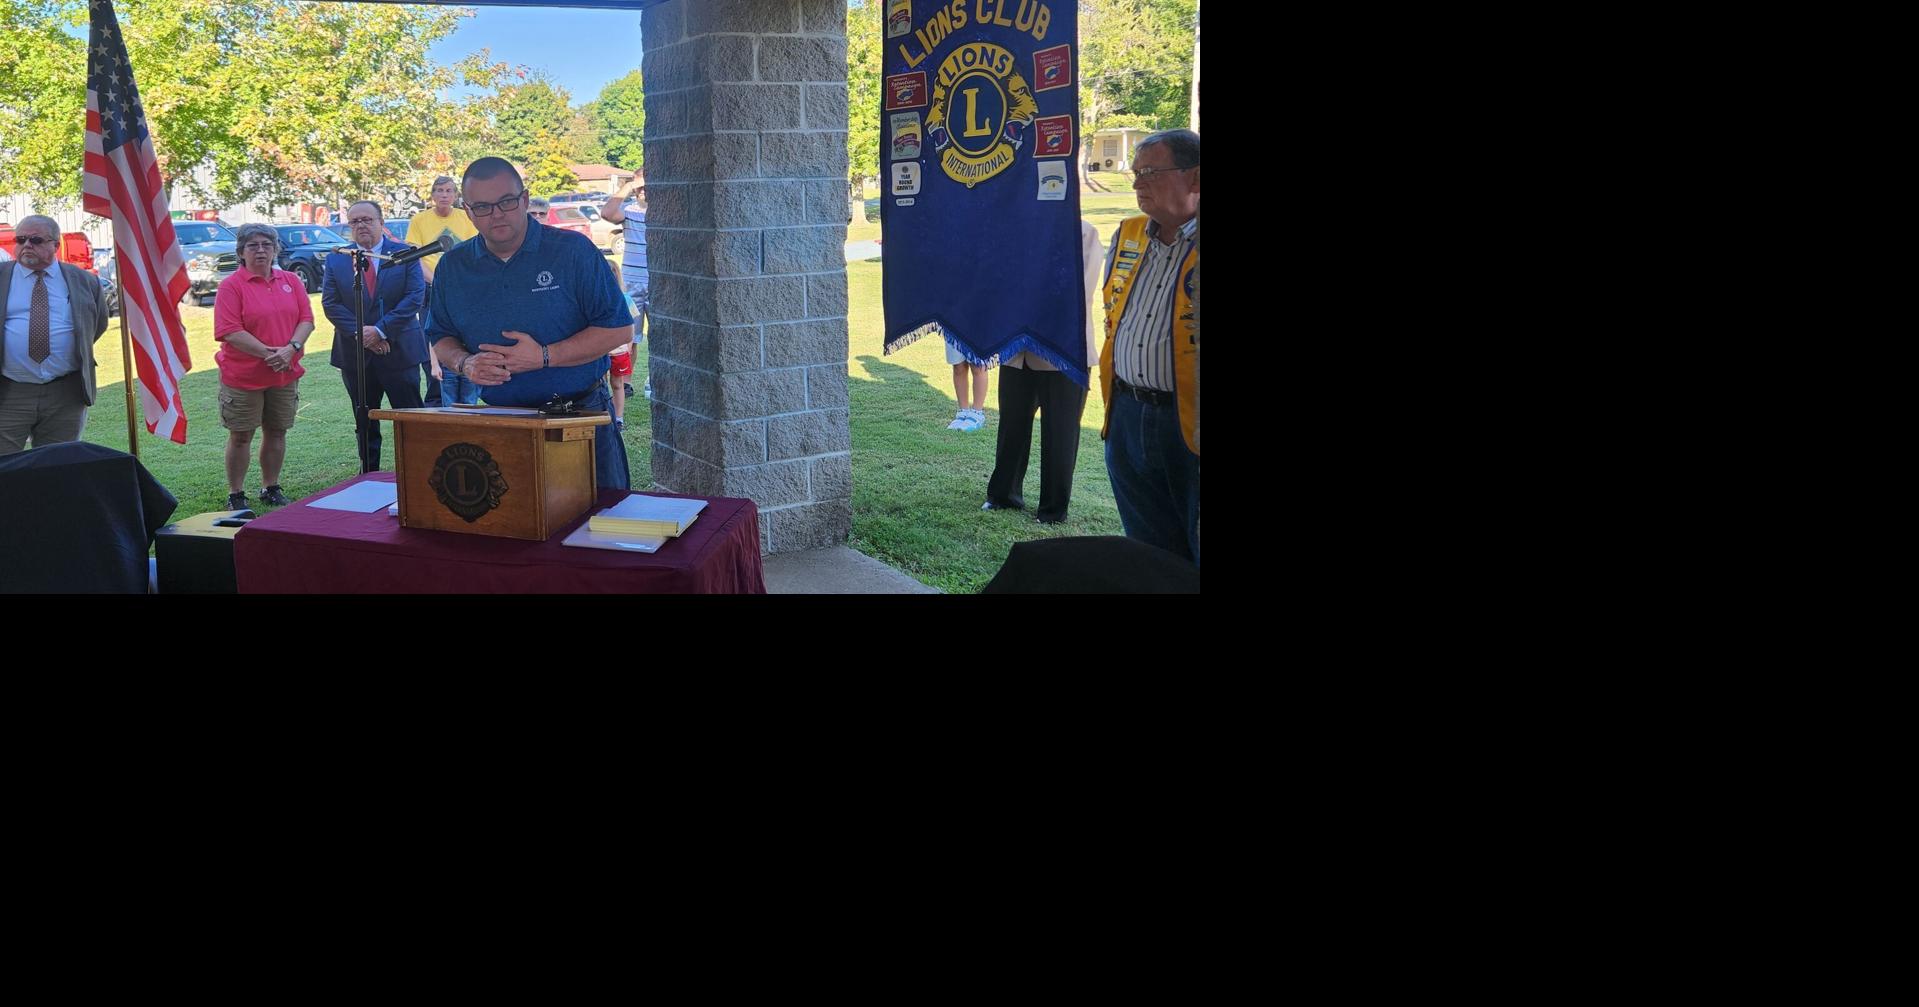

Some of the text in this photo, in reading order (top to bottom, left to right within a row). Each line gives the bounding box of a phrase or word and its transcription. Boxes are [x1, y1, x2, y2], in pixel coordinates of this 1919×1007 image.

[899, 0, 1051, 69] LIONS CLUB
[943, 45, 1010, 83] LIONS
[963, 87, 992, 138] L
[946, 150, 1009, 178] INTERNATIONAL
[457, 464, 478, 497] L
